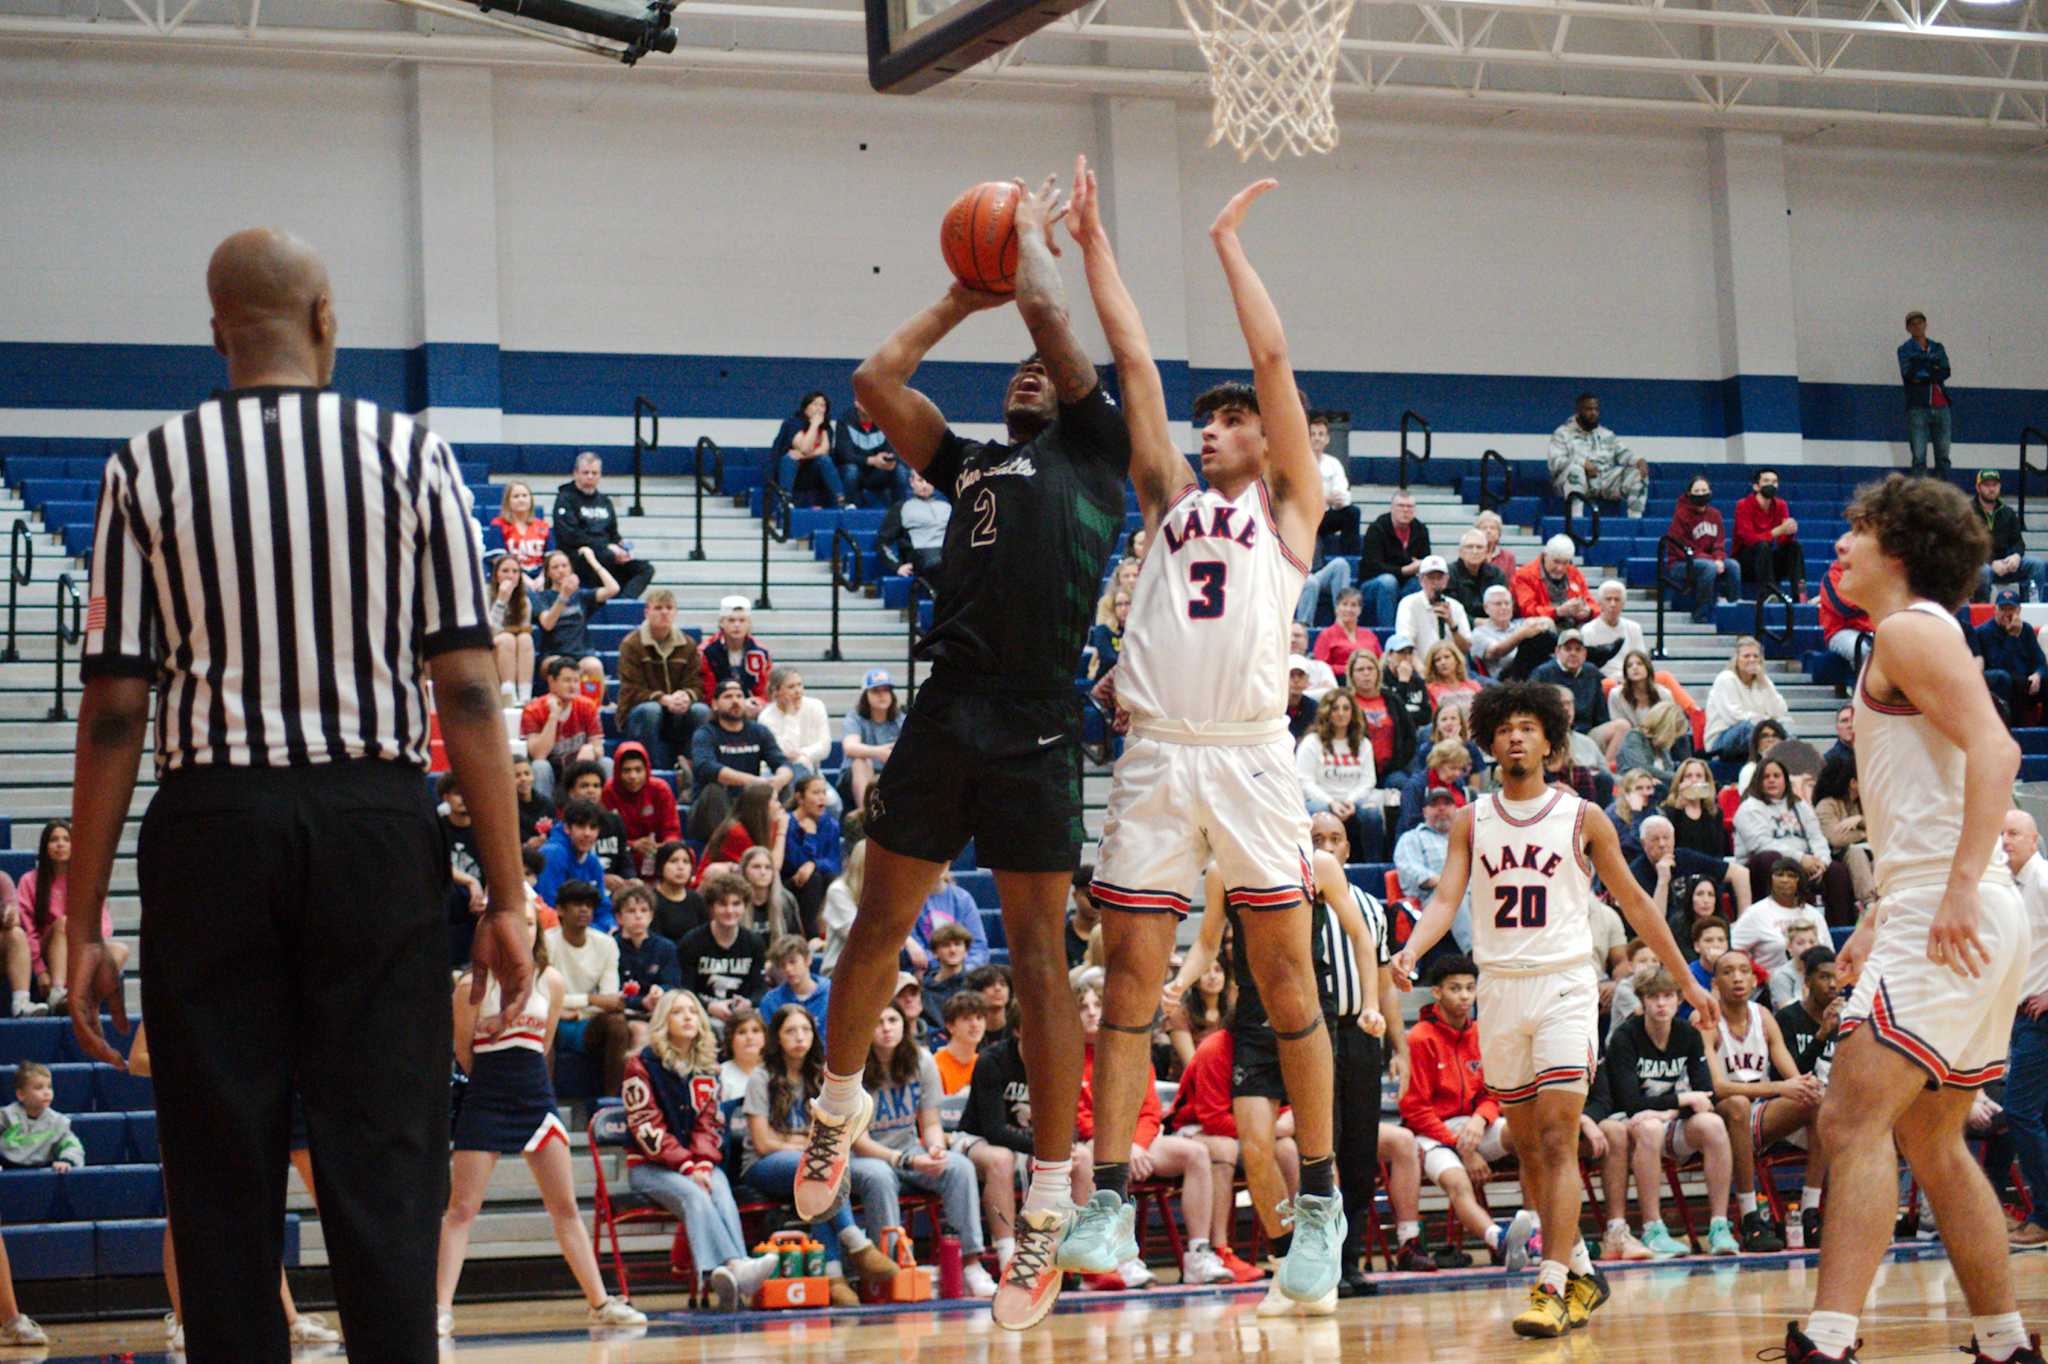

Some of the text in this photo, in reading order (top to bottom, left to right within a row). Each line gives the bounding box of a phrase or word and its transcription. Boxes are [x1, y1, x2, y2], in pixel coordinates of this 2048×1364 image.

[971, 487, 997, 547] 2
[1163, 506, 1256, 554] LAKE
[1188, 561, 1226, 620] 3
[1480, 844, 1563, 878] LAKE
[1495, 885, 1547, 928] 20
[1724, 1053, 1764, 1074] LAKE
[875, 1081, 920, 1121] AKE
[787, 1282, 806, 1304] G
